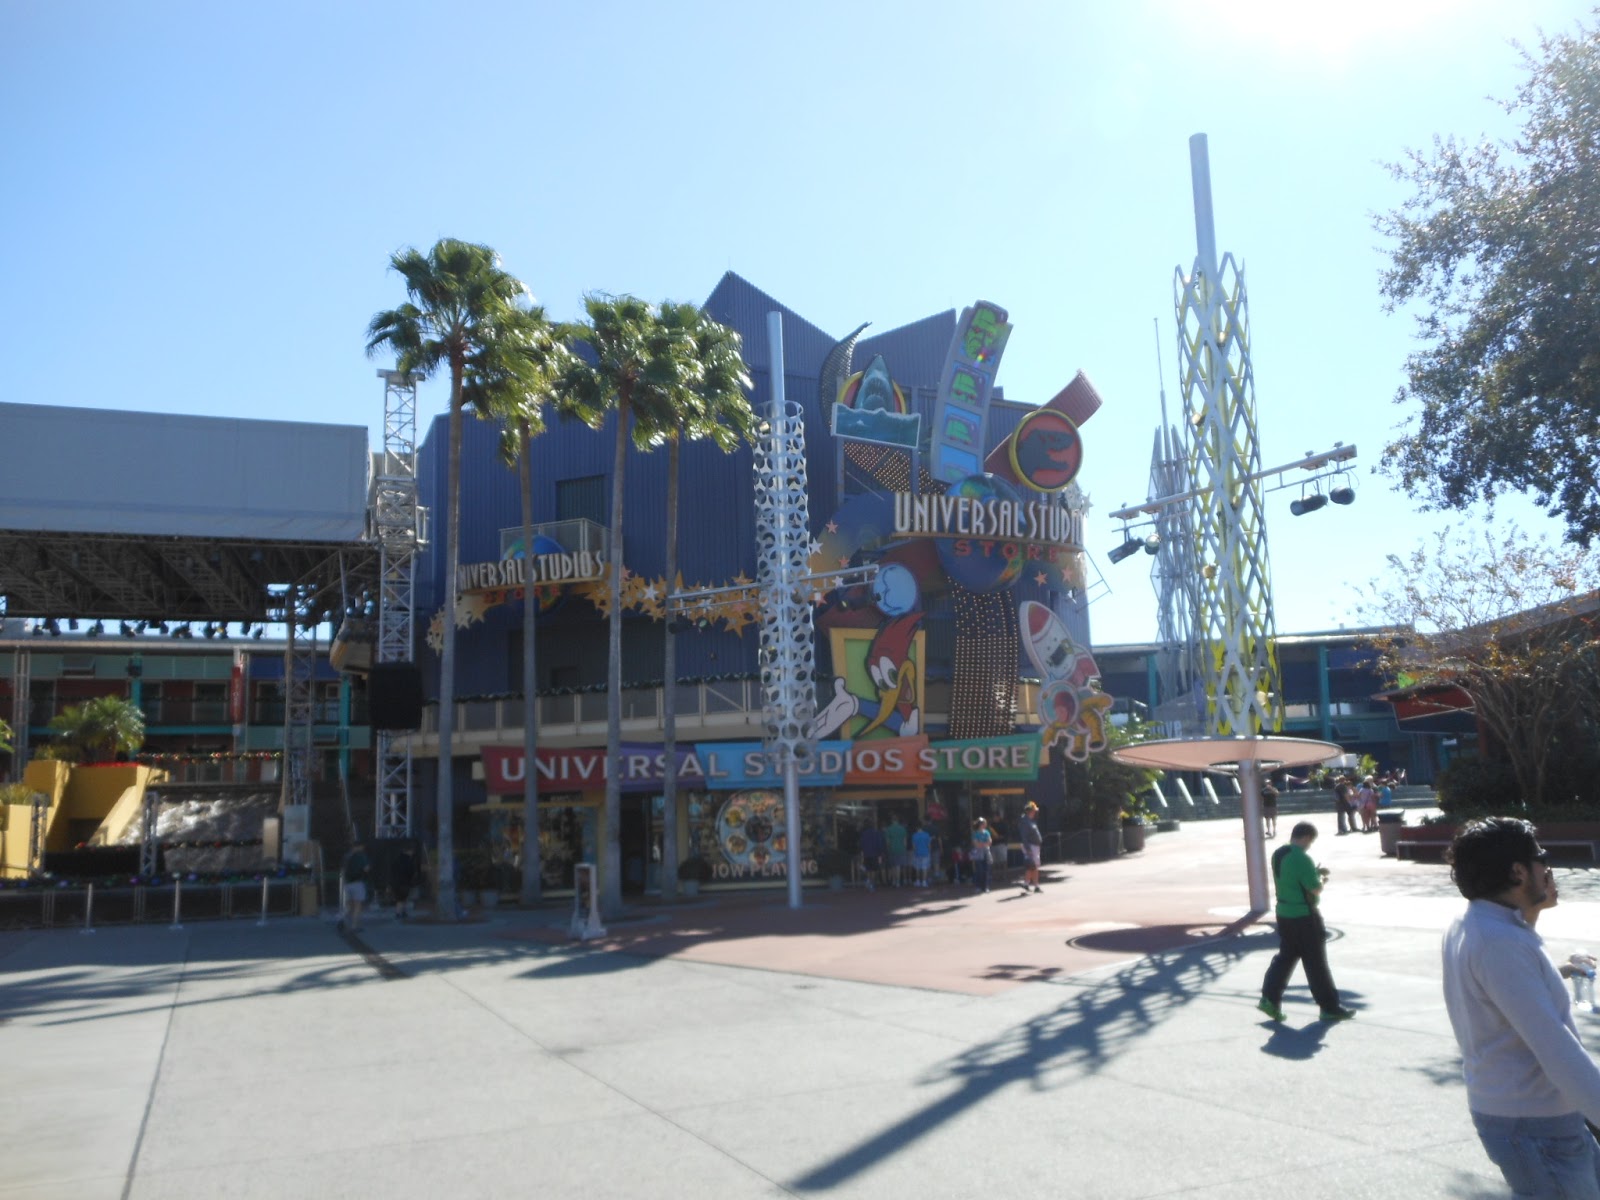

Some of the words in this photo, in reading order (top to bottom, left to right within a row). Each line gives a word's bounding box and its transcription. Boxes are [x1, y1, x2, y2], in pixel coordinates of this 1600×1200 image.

[895, 491, 1024, 538] UNIVERSAL
[955, 539, 1057, 563] STORE
[457, 558, 526, 591] NIVERSAL
[532, 550, 604, 582] STUDIOS
[919, 745, 1030, 772] STORE
[749, 859, 819, 877] PLAYNG
